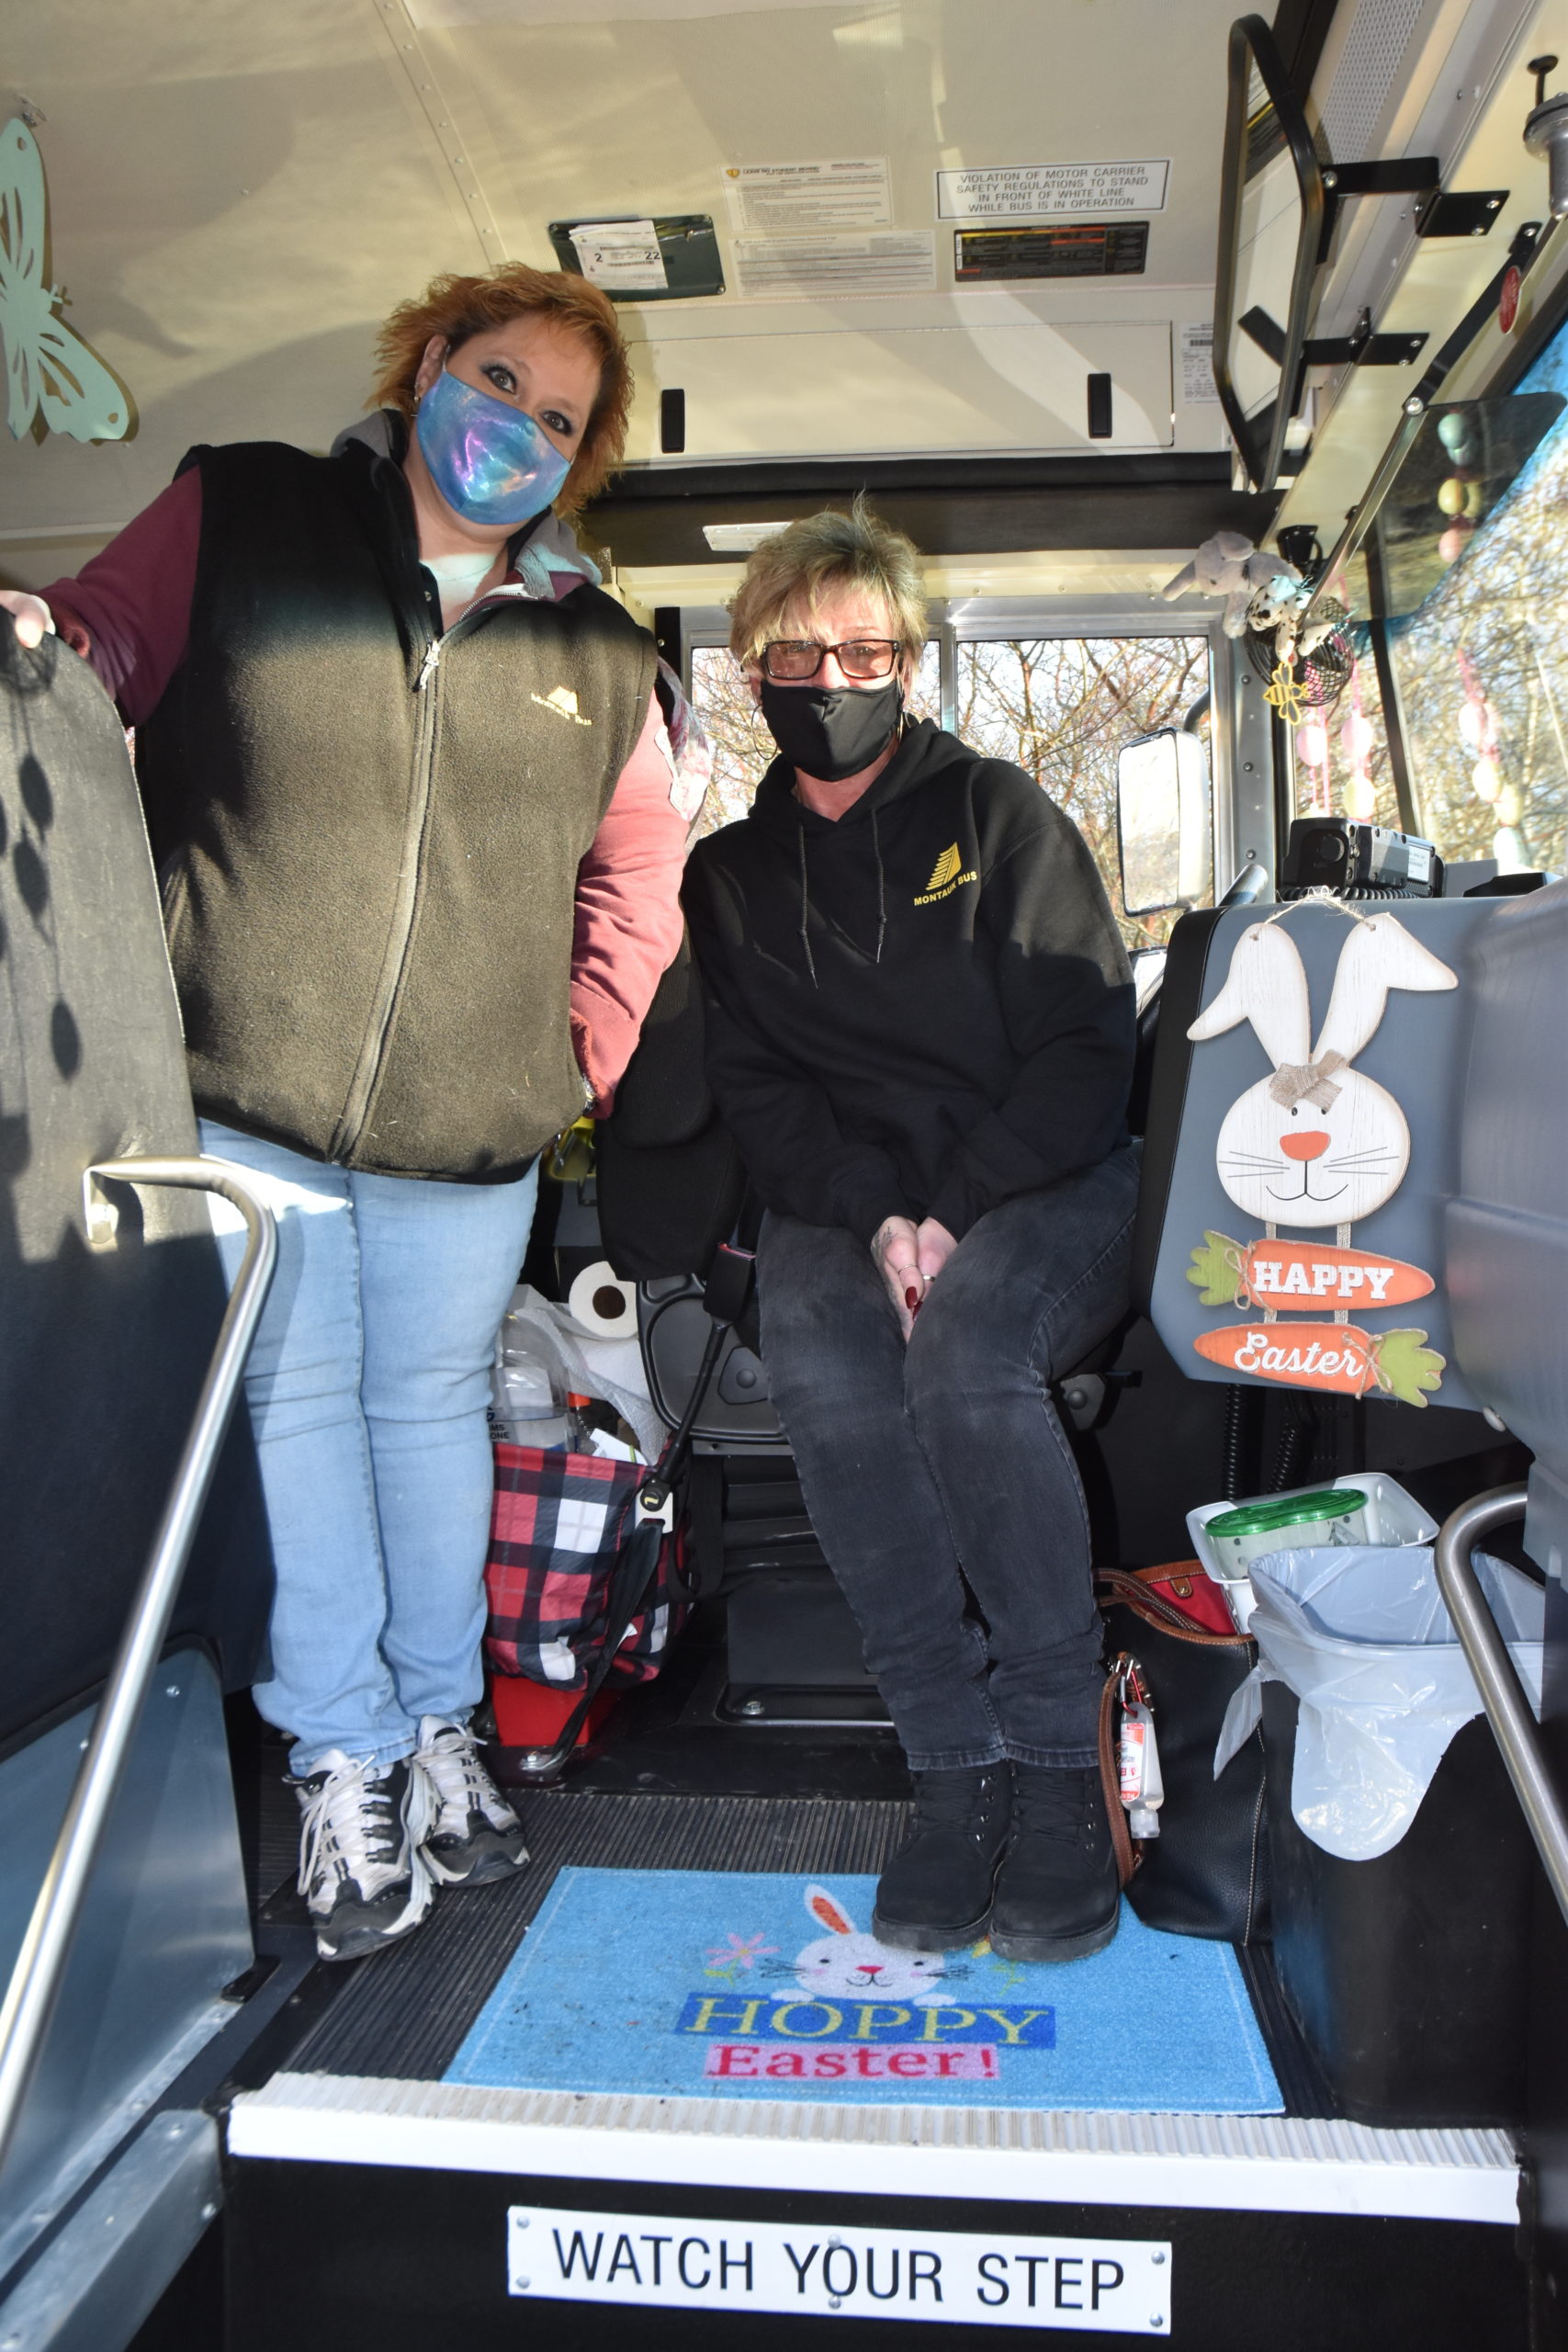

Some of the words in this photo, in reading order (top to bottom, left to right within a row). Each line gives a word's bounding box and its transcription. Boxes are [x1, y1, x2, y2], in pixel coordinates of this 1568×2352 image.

[956, 183, 998, 194] SAFETY
[1004, 179, 1084, 191] REGULATIONS
[1090, 178, 1104, 187] TO
[1111, 176, 1148, 186] STAND
[960, 172, 1020, 184] VIOLATION
[1026, 171, 1040, 180] OF
[1045, 168, 1088, 179] MOTOR
[1094, 166, 1145, 176] CARRIER
[968, 202, 1004, 212] WHILE
[1010, 201, 1032, 211] BUS
[1038, 199, 1049, 209] IS
[1054, 199, 1066, 209] IN
[1070, 197, 1134, 209] OPERATION
[978, 193, 990, 202] IN
[996, 191, 1032, 201] FRONT
[1038, 189, 1053, 199] OF
[1058, 187, 1094, 198] WHITE
[1100, 187, 1124, 197] LINE
[594, 253, 603, 263] 2
[644, 250, 660, 260] 22
[913, 880, 956, 906] MONTAUK
[957, 871, 977, 885] BUS
[1253, 1261, 1393, 1300] HAPPY
[1234, 1331, 1364, 1377] Easter
[684, 1997, 1051, 2044] HOPPY
[707, 2044, 997, 2079] Easter!
[552, 2228, 754, 2291] WATCH
[784, 2242, 944, 2302] YOUR
[976, 2253, 1126, 2311] STEP
